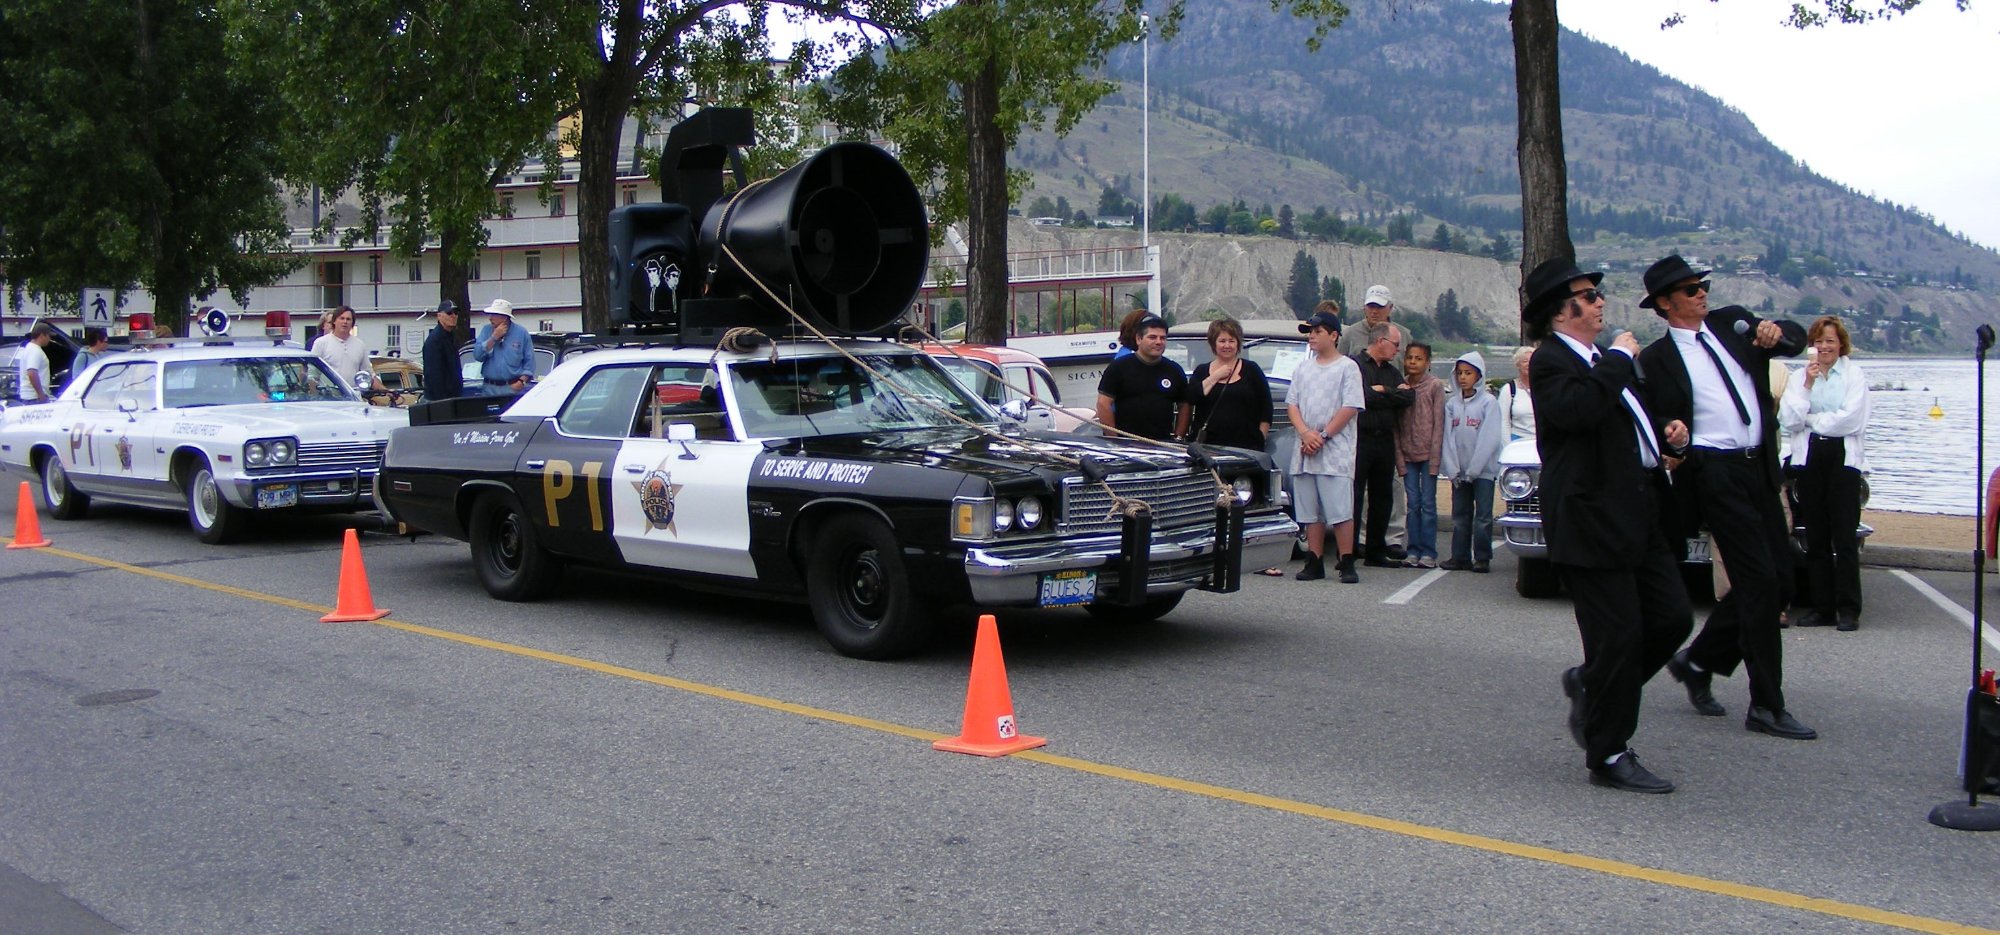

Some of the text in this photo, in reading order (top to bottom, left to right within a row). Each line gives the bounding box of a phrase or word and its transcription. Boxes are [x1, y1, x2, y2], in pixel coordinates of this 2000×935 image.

[760, 459, 873, 484] TO SERVE AND PROTECT
[543, 459, 603, 531] P1
[1043, 579, 1095, 599] BLUES 2
